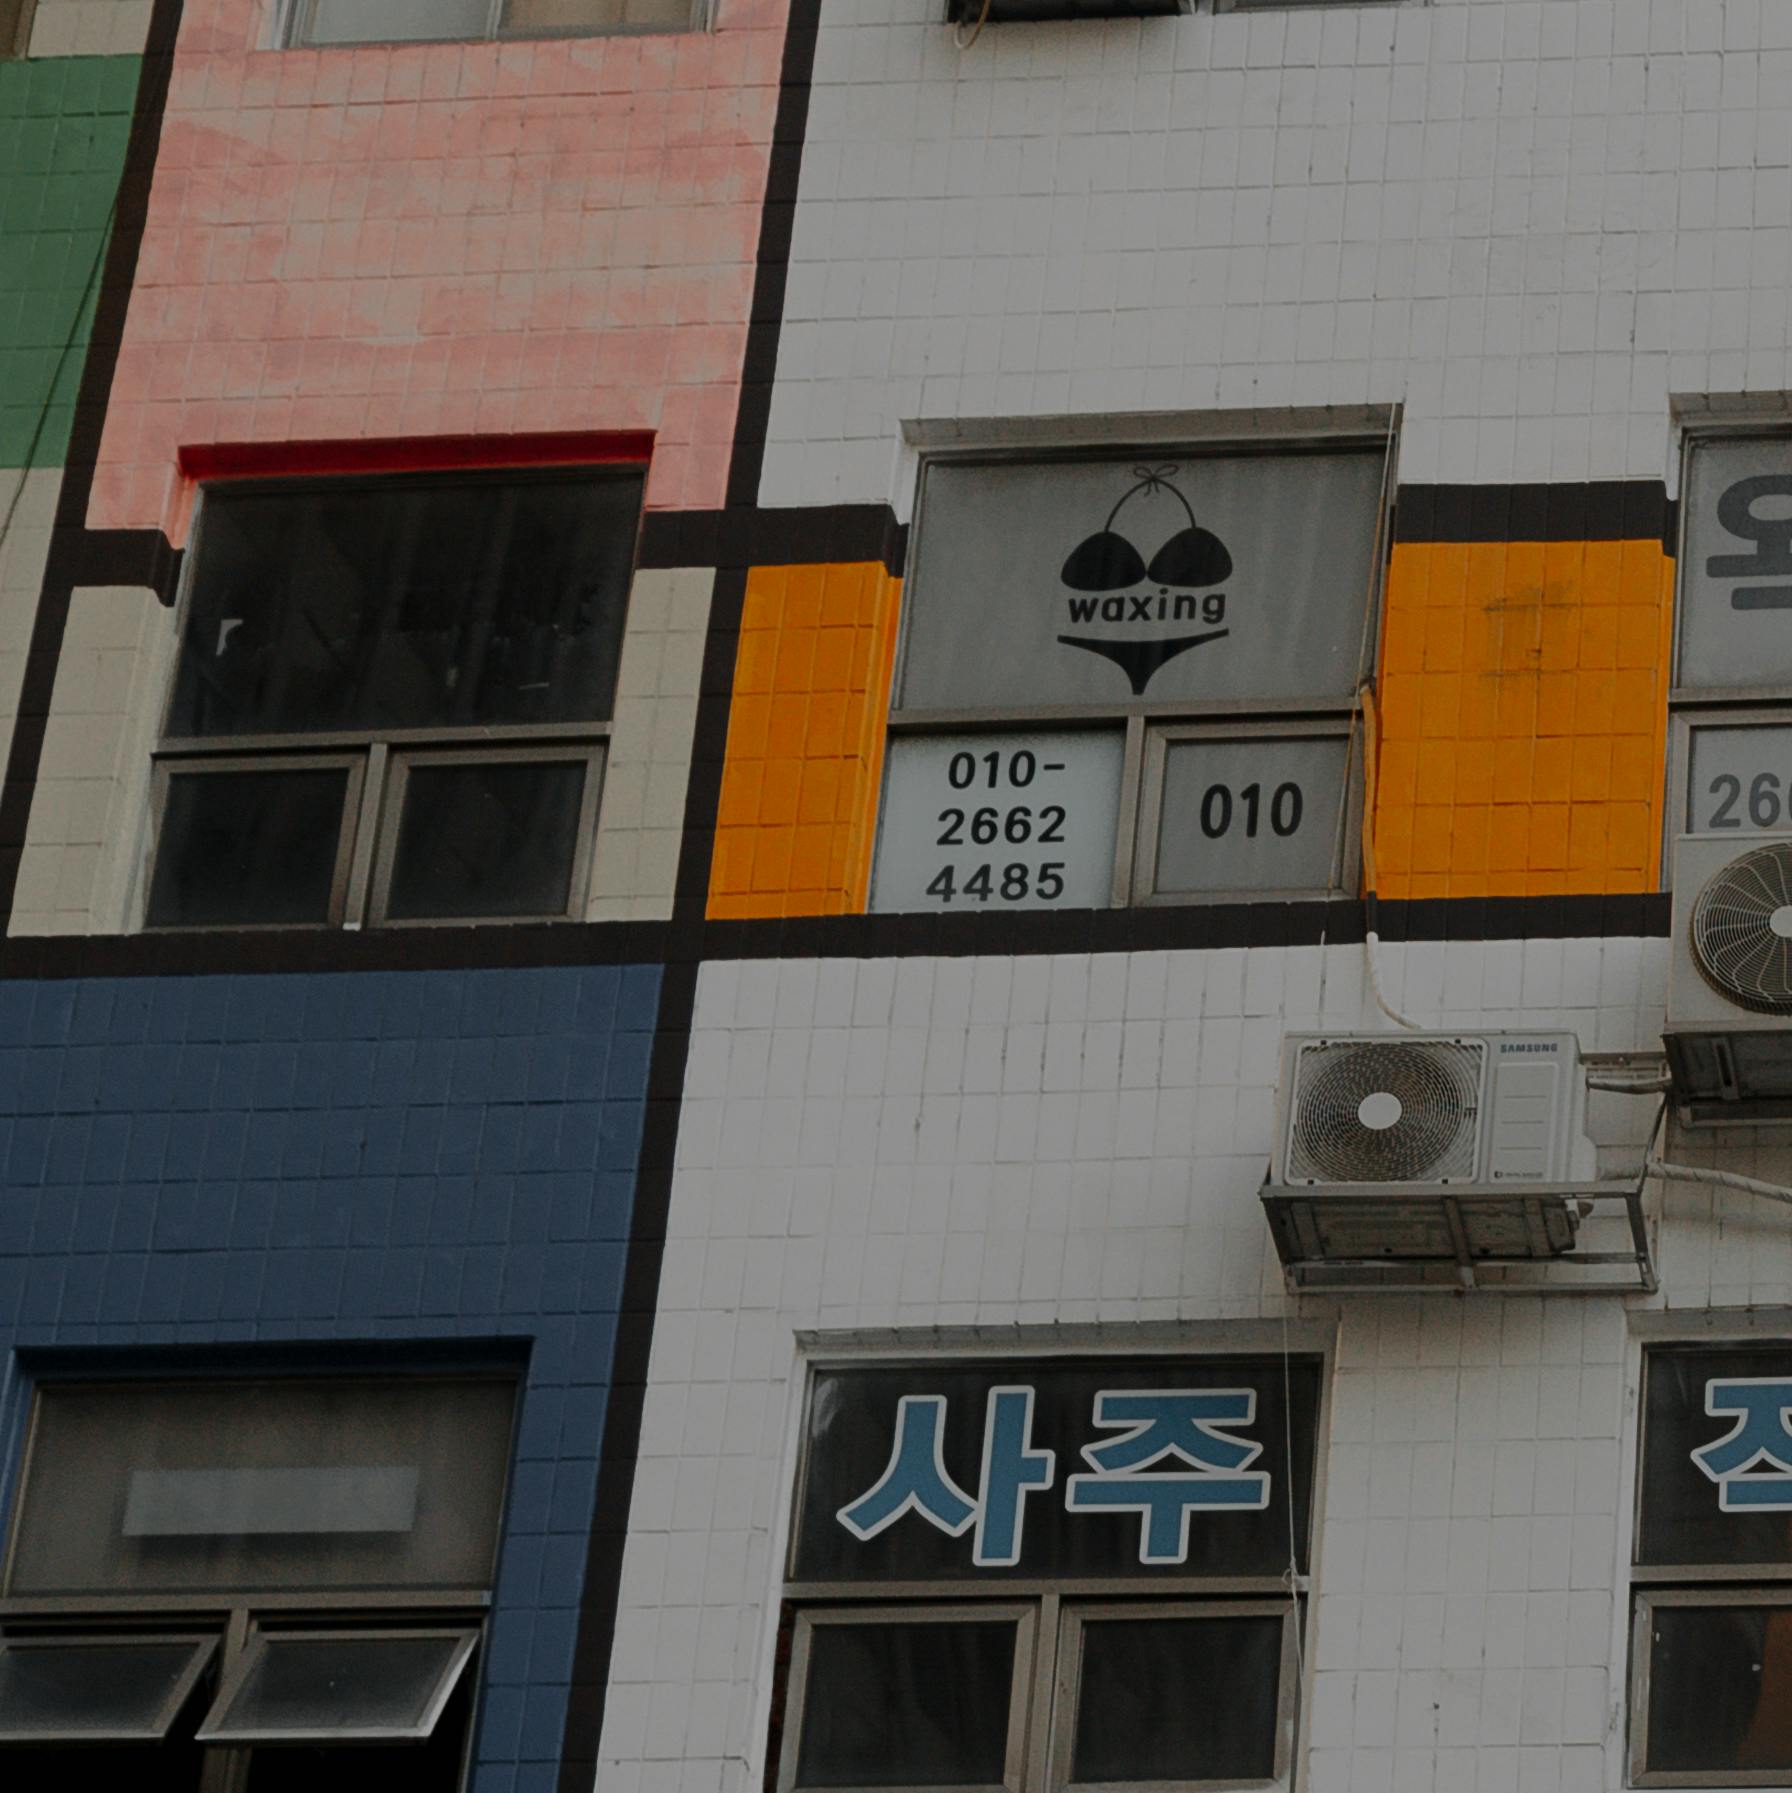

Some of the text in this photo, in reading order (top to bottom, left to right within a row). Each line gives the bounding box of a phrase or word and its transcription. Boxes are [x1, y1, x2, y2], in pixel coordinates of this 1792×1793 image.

[1068, 589, 1226, 625] waxing
[948, 749, 1066, 790] 010-
[936, 805, 1066, 846] 2662
[1199, 781, 1303, 840] 010
[925, 862, 1065, 904] 4485
[1500, 1043, 1558, 1053] SAMSUNG
[835, 1384, 1271, 1567] 사주
